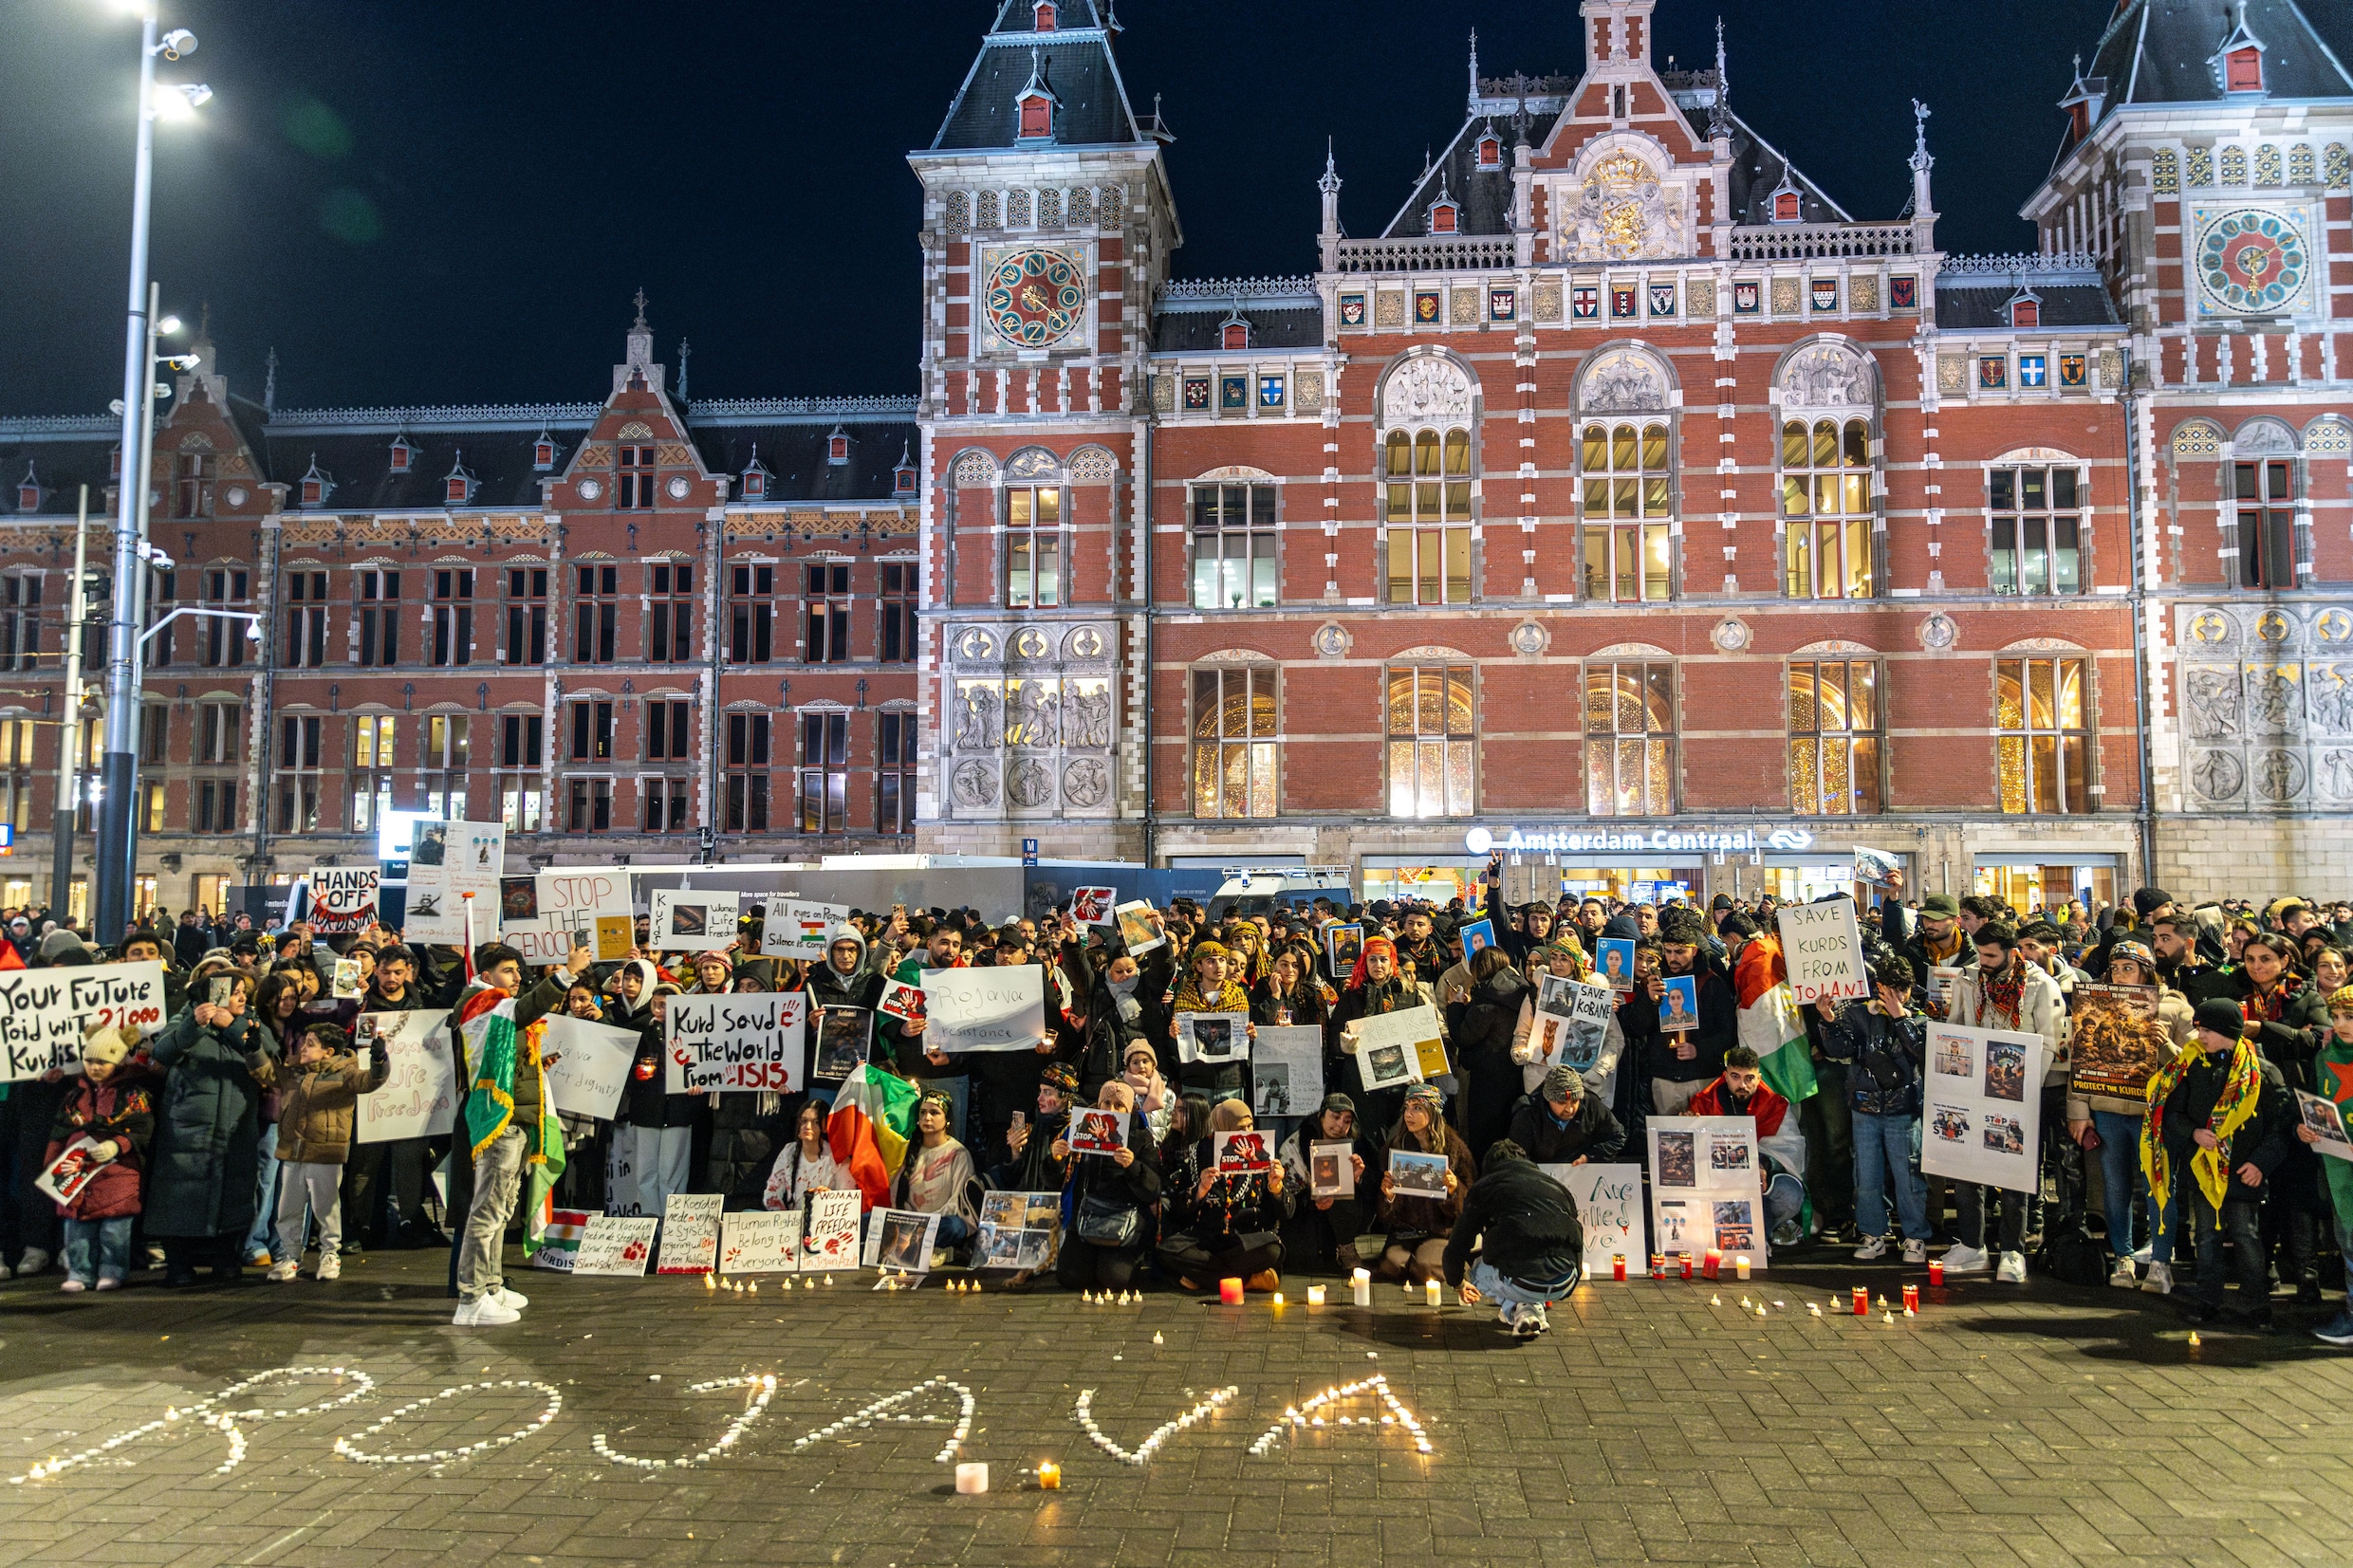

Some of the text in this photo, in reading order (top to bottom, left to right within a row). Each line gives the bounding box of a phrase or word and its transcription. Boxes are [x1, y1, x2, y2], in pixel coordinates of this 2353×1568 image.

[1028, 256, 1043, 272] N
[1027, 839, 1035, 852] M
[1507, 829, 1753, 851] Amsterdam Centraal
[313, 871, 379, 890] HANDS
[328, 890, 368, 908] OFF
[553, 877, 613, 909] STOP
[755, 891, 769, 899] space
[540, 909, 591, 932] THE
[712, 915, 734, 926] Life
[772, 902, 788, 917] All
[793, 910, 811, 924] eyes
[1793, 906, 1842, 926] SAVE
[708, 926, 737, 938] Freedom
[768, 933, 795, 947] Silence
[806, 937, 828, 953] compl
[1797, 935, 1848, 954] KURDS
[1802, 959, 1850, 980] FROM
[0, 977, 62, 1015] Your
[1581, 986, 1607, 1001] SAVE
[1793, 980, 1866, 1002] JOLANI
[2085, 983, 2108, 992] KURDS
[1576, 998, 1612, 1020] KOBANE
[674, 1004, 715, 1040] Kurd
[942, 1025, 1012, 1039] resistance
[683, 1061, 789, 1090] From ISIS
[575, 1073, 621, 1098] dignity
[2073, 1079, 2105, 1092] PROTECT
[2119, 1085, 2147, 1098] KURDS
[367, 1090, 450, 1122] Freedom
[1221, 1154, 1239, 1163] STOP
[667, 1195, 681, 1209] De
[820, 1191, 860, 1200] WOMAN
[824, 1202, 852, 1217] LIFE
[1577, 1202, 1629, 1227] illed
[728, 1212, 802, 1232] Human Rights
[814, 1218, 859, 1236] FREEDOM
[738, 1233, 791, 1248] Belong to
[732, 1252, 787, 1270] Everyone
